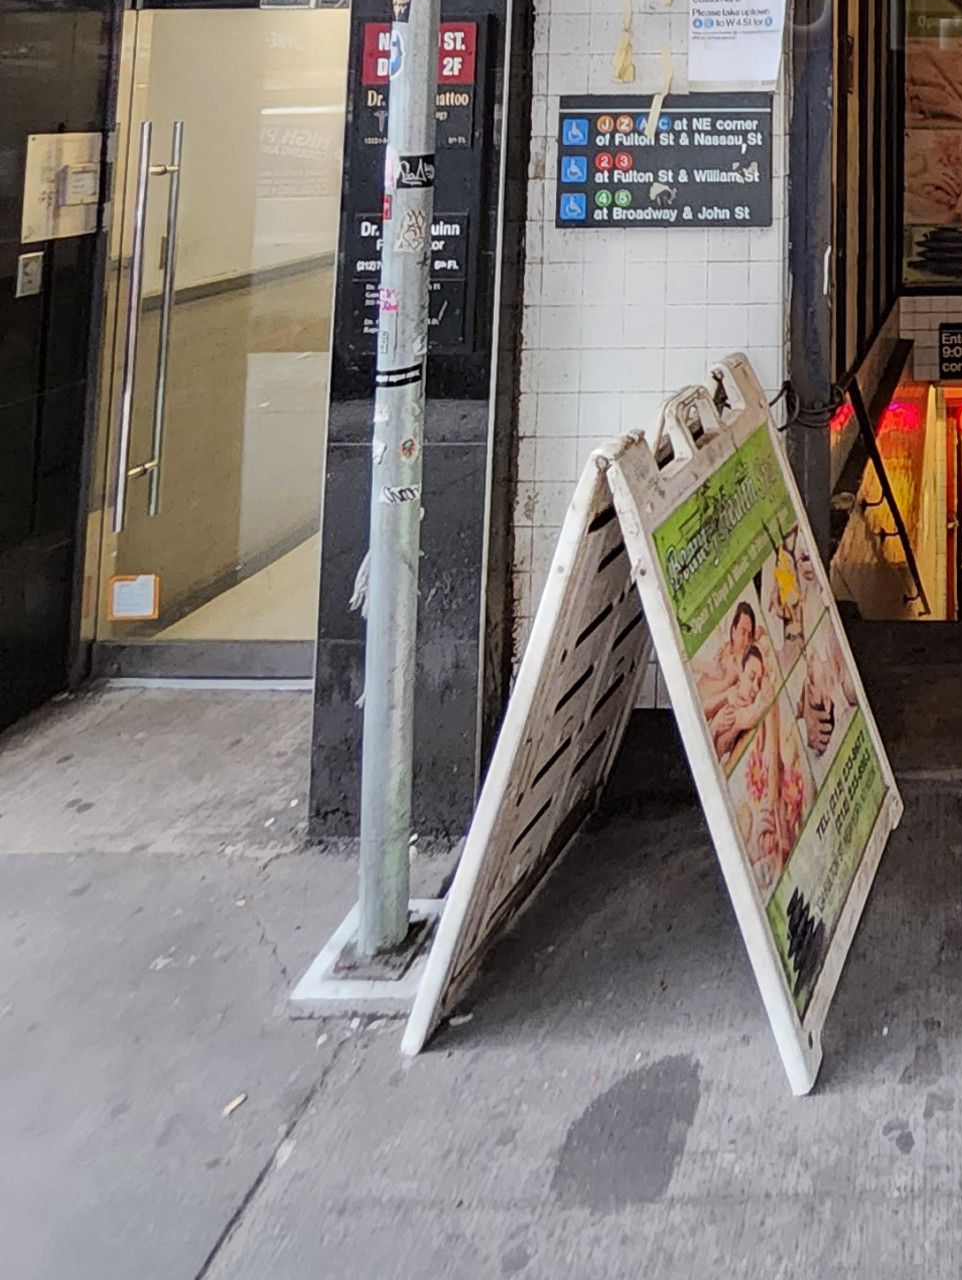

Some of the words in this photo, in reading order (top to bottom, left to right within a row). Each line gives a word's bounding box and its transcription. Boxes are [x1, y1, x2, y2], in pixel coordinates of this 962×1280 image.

[691, 8, 721, 17] Please
[722, 8, 741, 17] take
[443, 31, 466, 51] ST.
[442, 56, 463, 76] 2F
[366, 89, 386, 107] Dr.
[673, 117, 688, 131] at
[692, 117, 712, 131] NE
[715, 118, 759, 131] corner
[595, 132, 611, 146] of
[614, 132, 655, 146] Fulton
[659, 132, 675, 146] St
[678, 132, 690, 146] &
[693, 132, 743, 146] Nassau
[746, 132, 763, 146] St
[594, 170, 609, 183] at
[613, 170, 653, 183] Fulton
[658, 169, 674, 183] St
[678, 169, 689, 183] &
[693, 169, 740, 183] William
[744, 169, 760, 183] St
[593, 207, 608, 220] at
[612, 206, 678, 222] Broadway
[682, 206, 693, 220] &
[697, 206, 730, 220] John
[734, 206, 750, 220] St
[360, 221, 380, 237] Dr.
[431, 220, 461, 236] uinn
